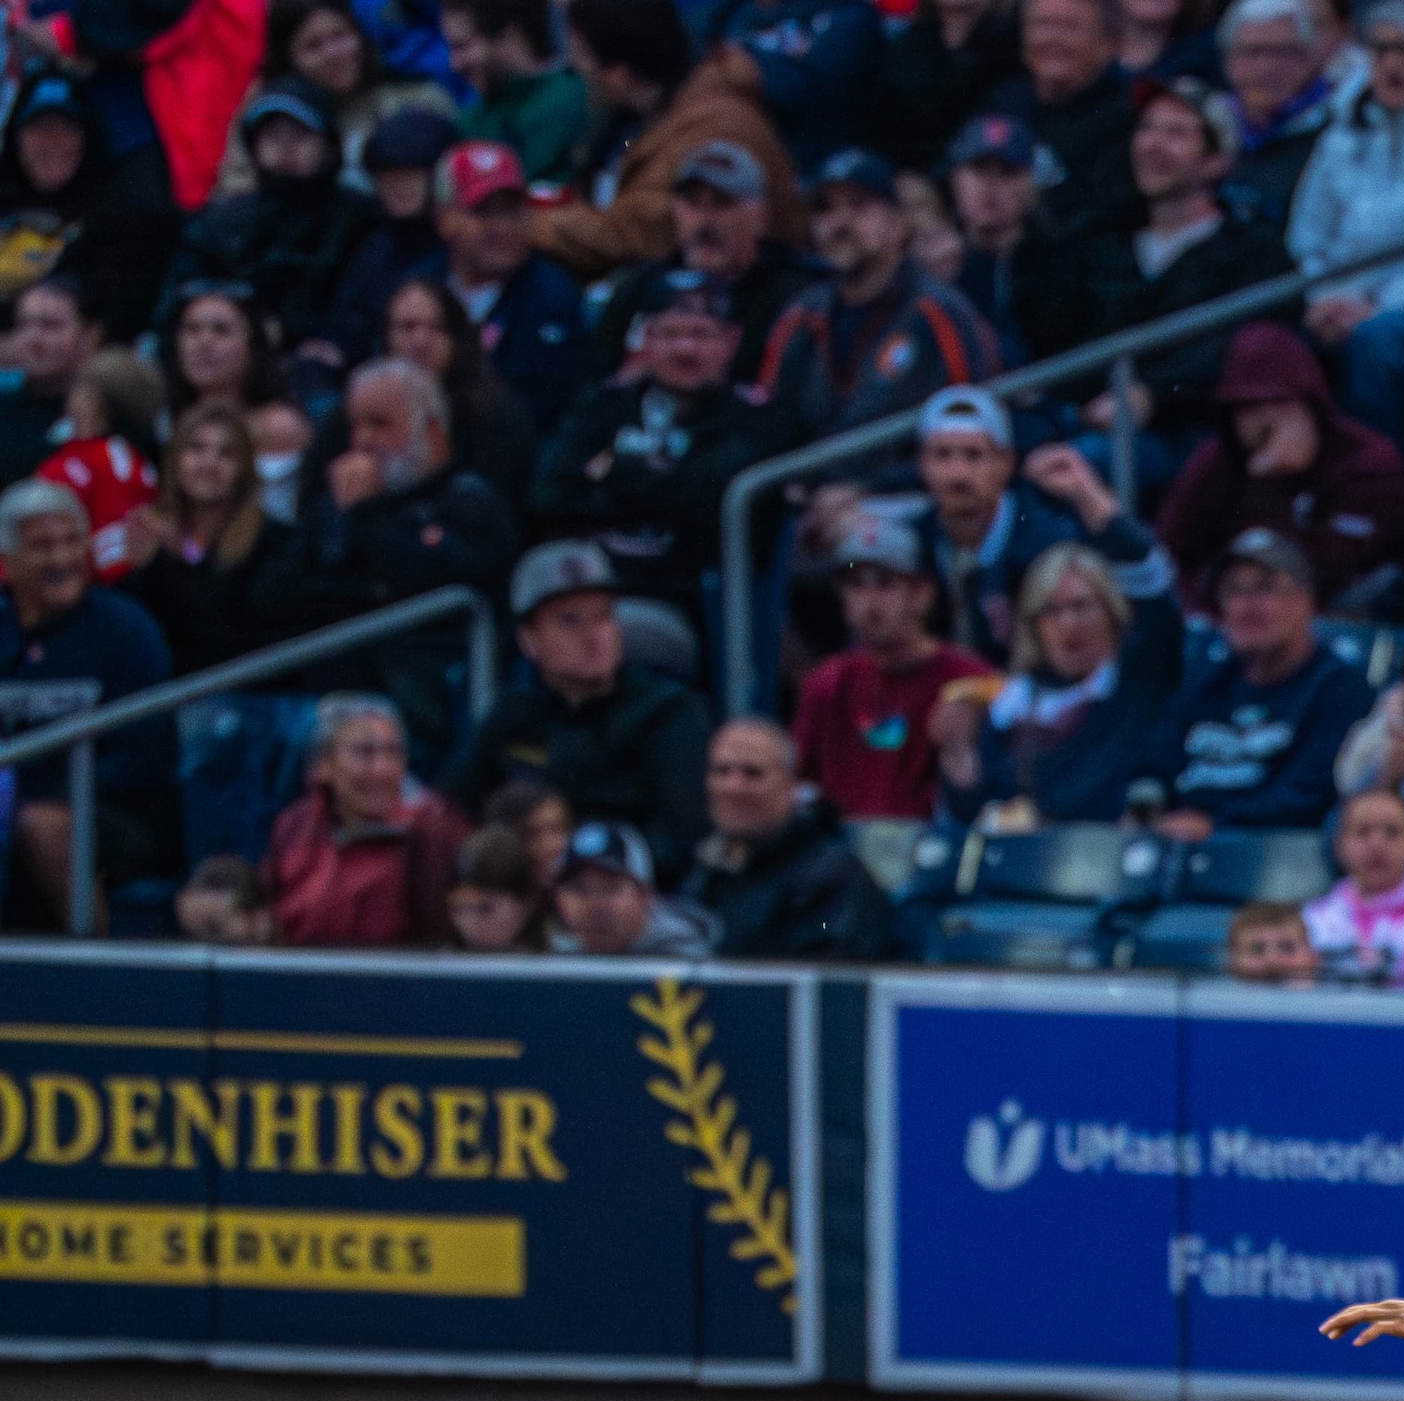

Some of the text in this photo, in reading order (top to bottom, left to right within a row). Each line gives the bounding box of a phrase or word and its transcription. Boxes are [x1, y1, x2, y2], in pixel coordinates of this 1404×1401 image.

[1055, 1118, 1200, 1176] UMass
[0, 1219, 433, 1277] OME SERVICES
[1169, 1233, 1397, 1300] Fairlawn
